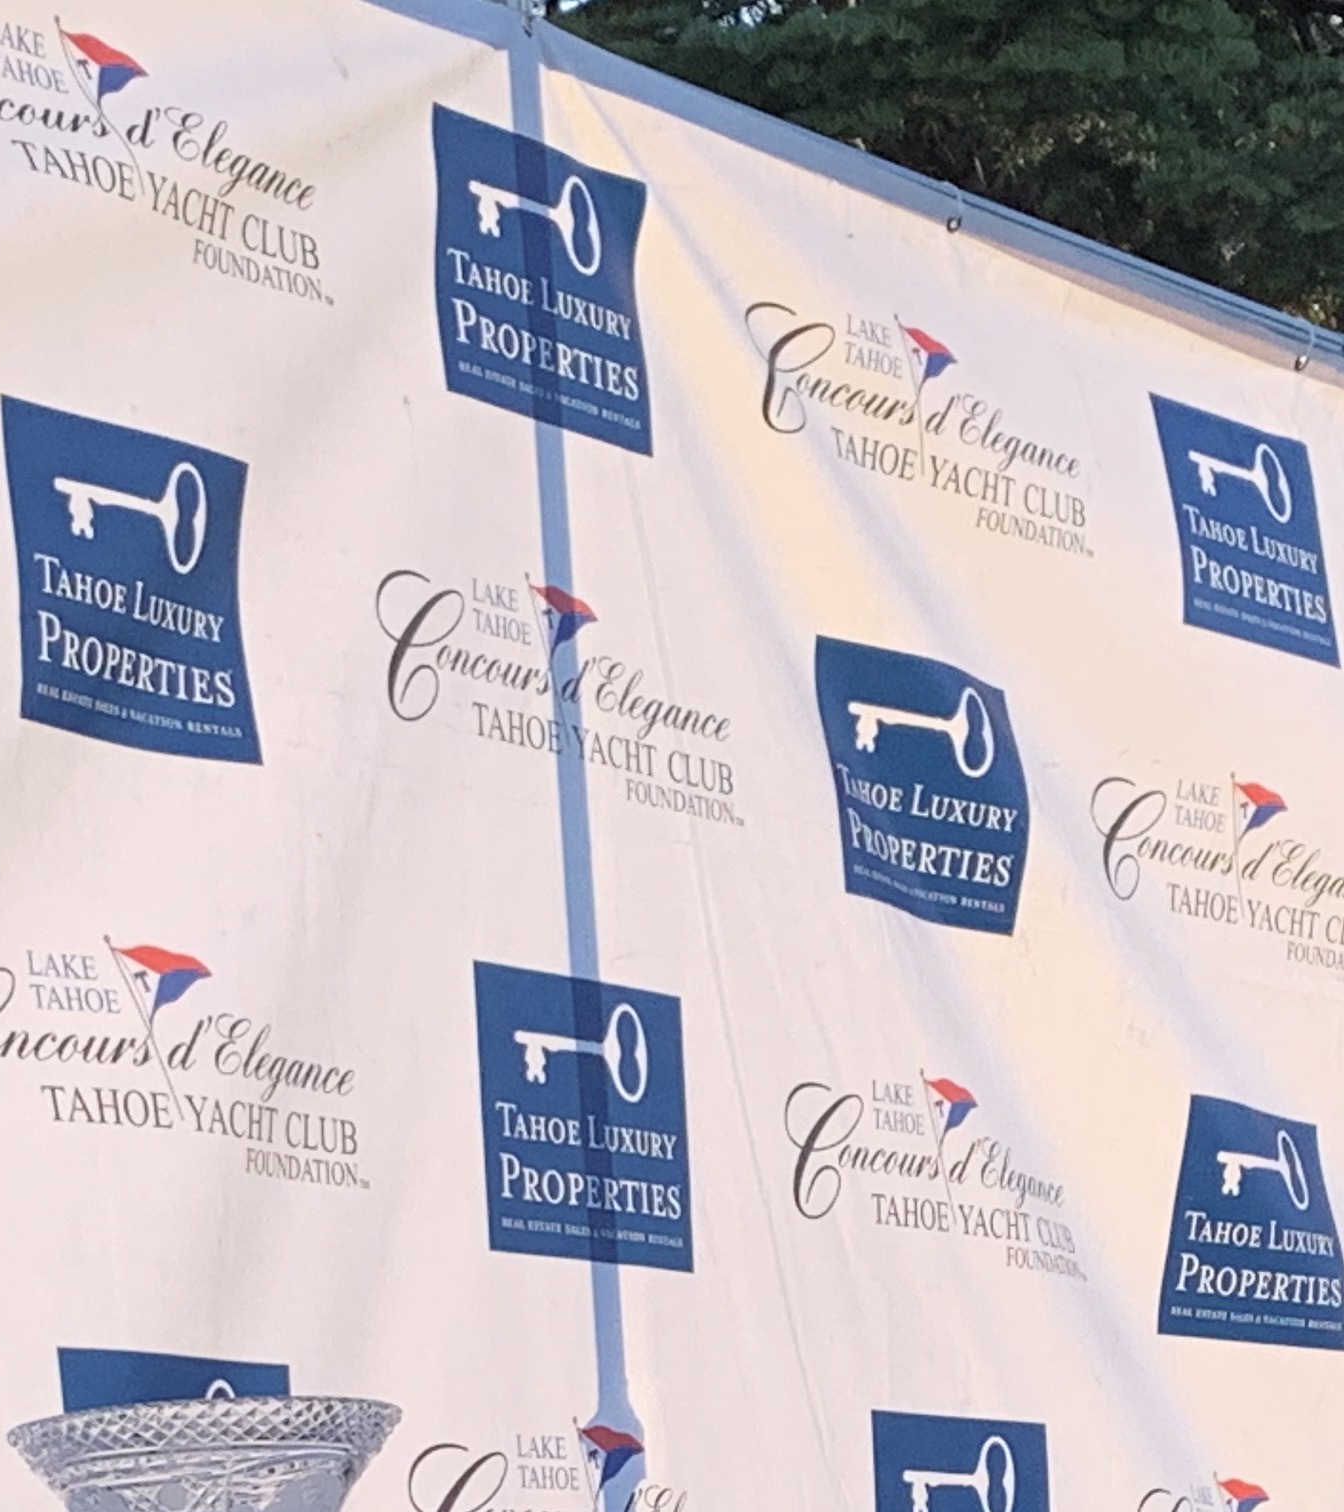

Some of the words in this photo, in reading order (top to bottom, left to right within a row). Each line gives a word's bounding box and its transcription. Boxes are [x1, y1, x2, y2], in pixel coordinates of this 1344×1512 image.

[11, 139, 135, 201] TAHOE
[147, 171, 233, 240] YACHT
[241, 213, 319, 269] CLUB
[193, 239, 322, 299] FOUNDATION
[447, 248, 534, 305] TAHOE
[540, 277, 630, 340] LUXURY
[452, 298, 639, 400] PROPERTIES
[843, 341, 903, 379] TAHOE
[846, 314, 891, 348] LAKE
[745, 302, 915, 433] Concours
[831, 426, 918, 482] TAHOE
[929, 455, 1015, 508] YACHT
[1024, 483, 1086, 527] CLUB
[1182, 504, 1248, 551] TAHOE
[1251, 527, 1318, 575] LUXURY
[34, 553, 126, 614] TAHOE
[133, 581, 224, 642] LUXURY
[472, 578, 519, 612] LAKE
[1190, 545, 1327, 624] PROPERTIES
[376, 569, 550, 722] Concours
[472, 608, 531, 646] TAHOE
[37, 610, 235, 708] PROPERTIES
[472, 702, 562, 755] TAHOE
[571, 725, 657, 777] YACHT
[668, 751, 733, 794] CLUB
[836, 764, 903, 813] TAHOE
[910, 784, 1017, 833] LUXURY
[1175, 805, 1226, 833] TAHOE
[1176, 779, 1220, 807] LAKE
[847, 808, 1012, 888] PROPERTIES
[1090, 777, 1234, 901] Concours
[1167, 882, 1239, 924] TAHOE
[1247, 899, 1320, 940] YACHT
[27, 949, 99, 981] LAKE
[29, 983, 122, 1015] TAHOE
[41, 1085, 174, 1128] TAHOE
[184, 1095, 278, 1144] YACHT
[284, 1111, 358, 1155] CLUB
[872, 1080, 913, 1106] LAKE
[874, 1108, 925, 1136] TAHOE
[495, 1101, 581, 1146] TAHOE
[588, 1115, 677, 1160] LUXURY
[785, 1082, 939, 1220] Concours
[246, 1148, 359, 1188] FOUNDATION
[499, 1152, 681, 1220] PROPERTIES
[871, 1194, 950, 1232] TAHOE
[959, 1204, 1031, 1242] YACHT
[1036, 1216, 1075, 1253] CLUB
[1185, 1210, 1263, 1248] TAHOE
[1268, 1220, 1334, 1257] LUXURY
[1175, 1253, 1342, 1307] PROPERTIES
[516, 1434, 566, 1460] LAKE
[518, 1465, 579, 1491] TAHOE
